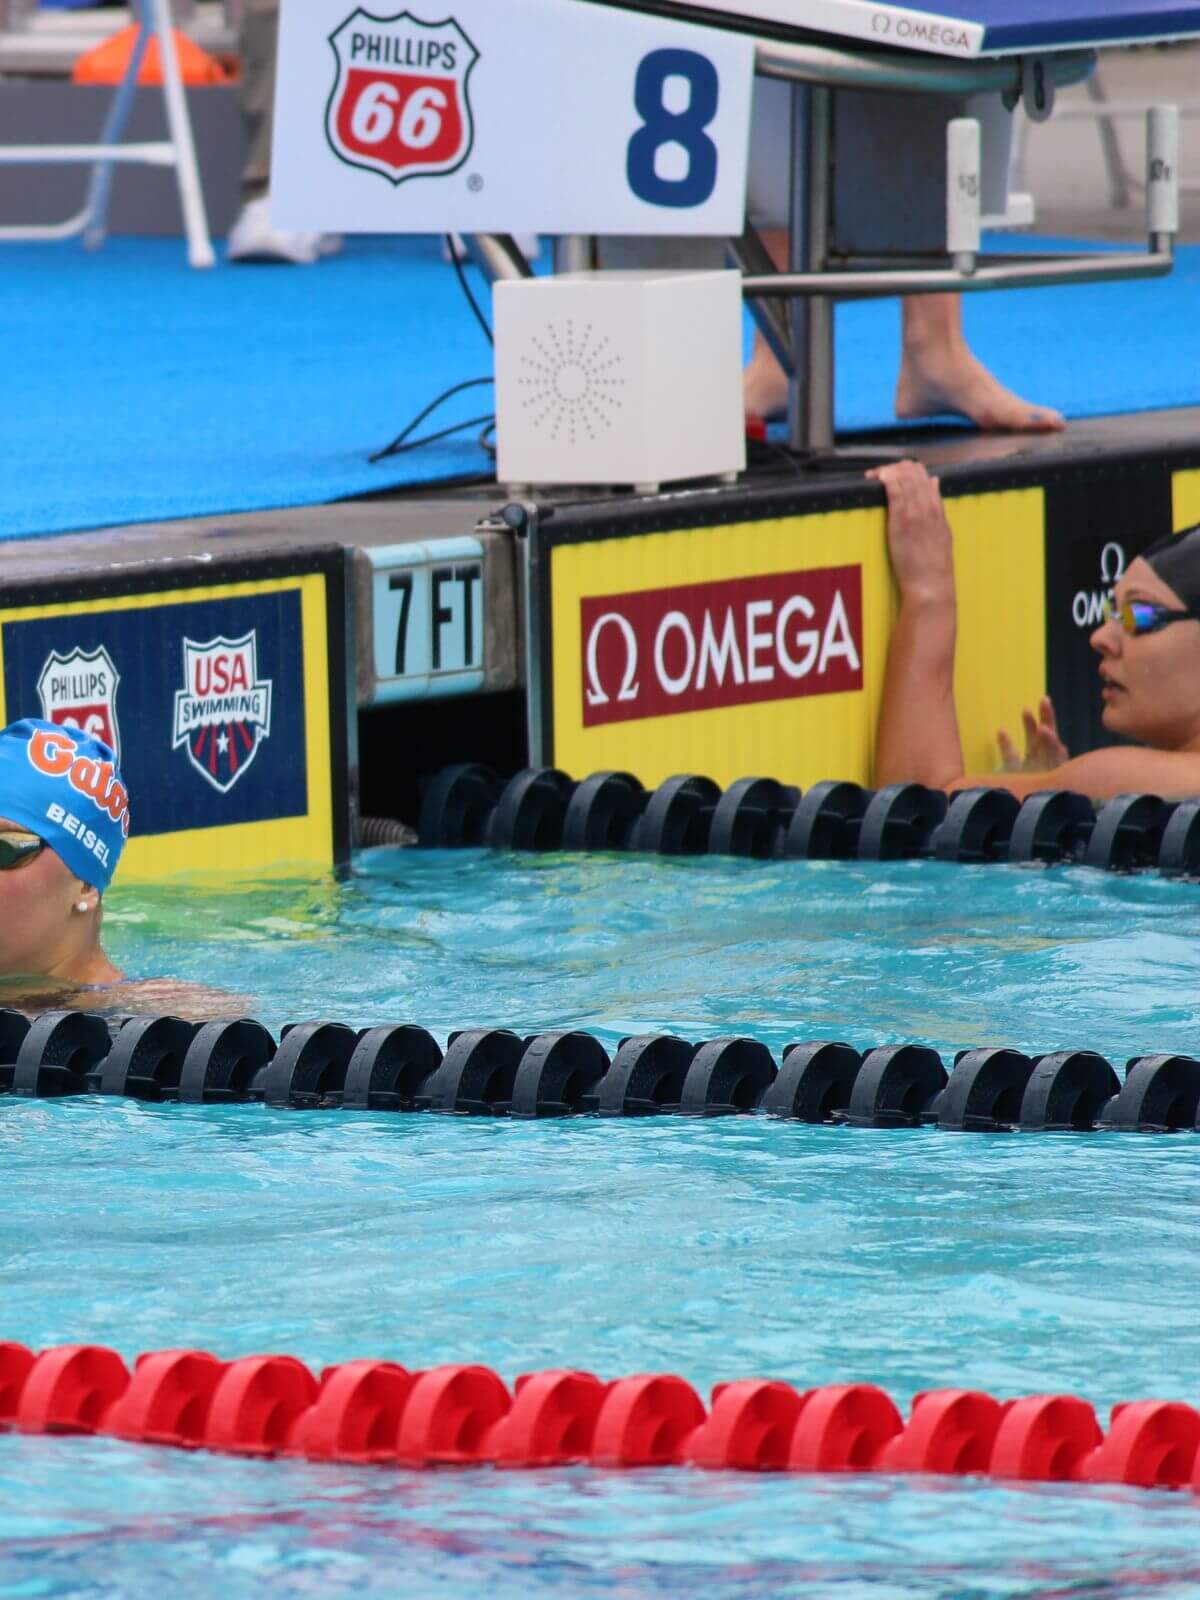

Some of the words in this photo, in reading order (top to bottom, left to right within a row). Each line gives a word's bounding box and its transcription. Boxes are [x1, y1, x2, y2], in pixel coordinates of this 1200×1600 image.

[351, 32, 457, 70] PHILLIPS
[896, 19, 968, 49] OMEGA
[350, 81, 448, 149] 66
[626, 47, 719, 208] 8
[389, 573, 413, 675] 7
[432, 565, 480, 669] FT
[654, 589, 860, 695] OMEGA
[51, 672, 107, 702] PHILLIPS
[195, 653, 249, 696] USA
[183, 694, 260, 723] SWIMMING
[46, 803, 109, 868] BEISEL
